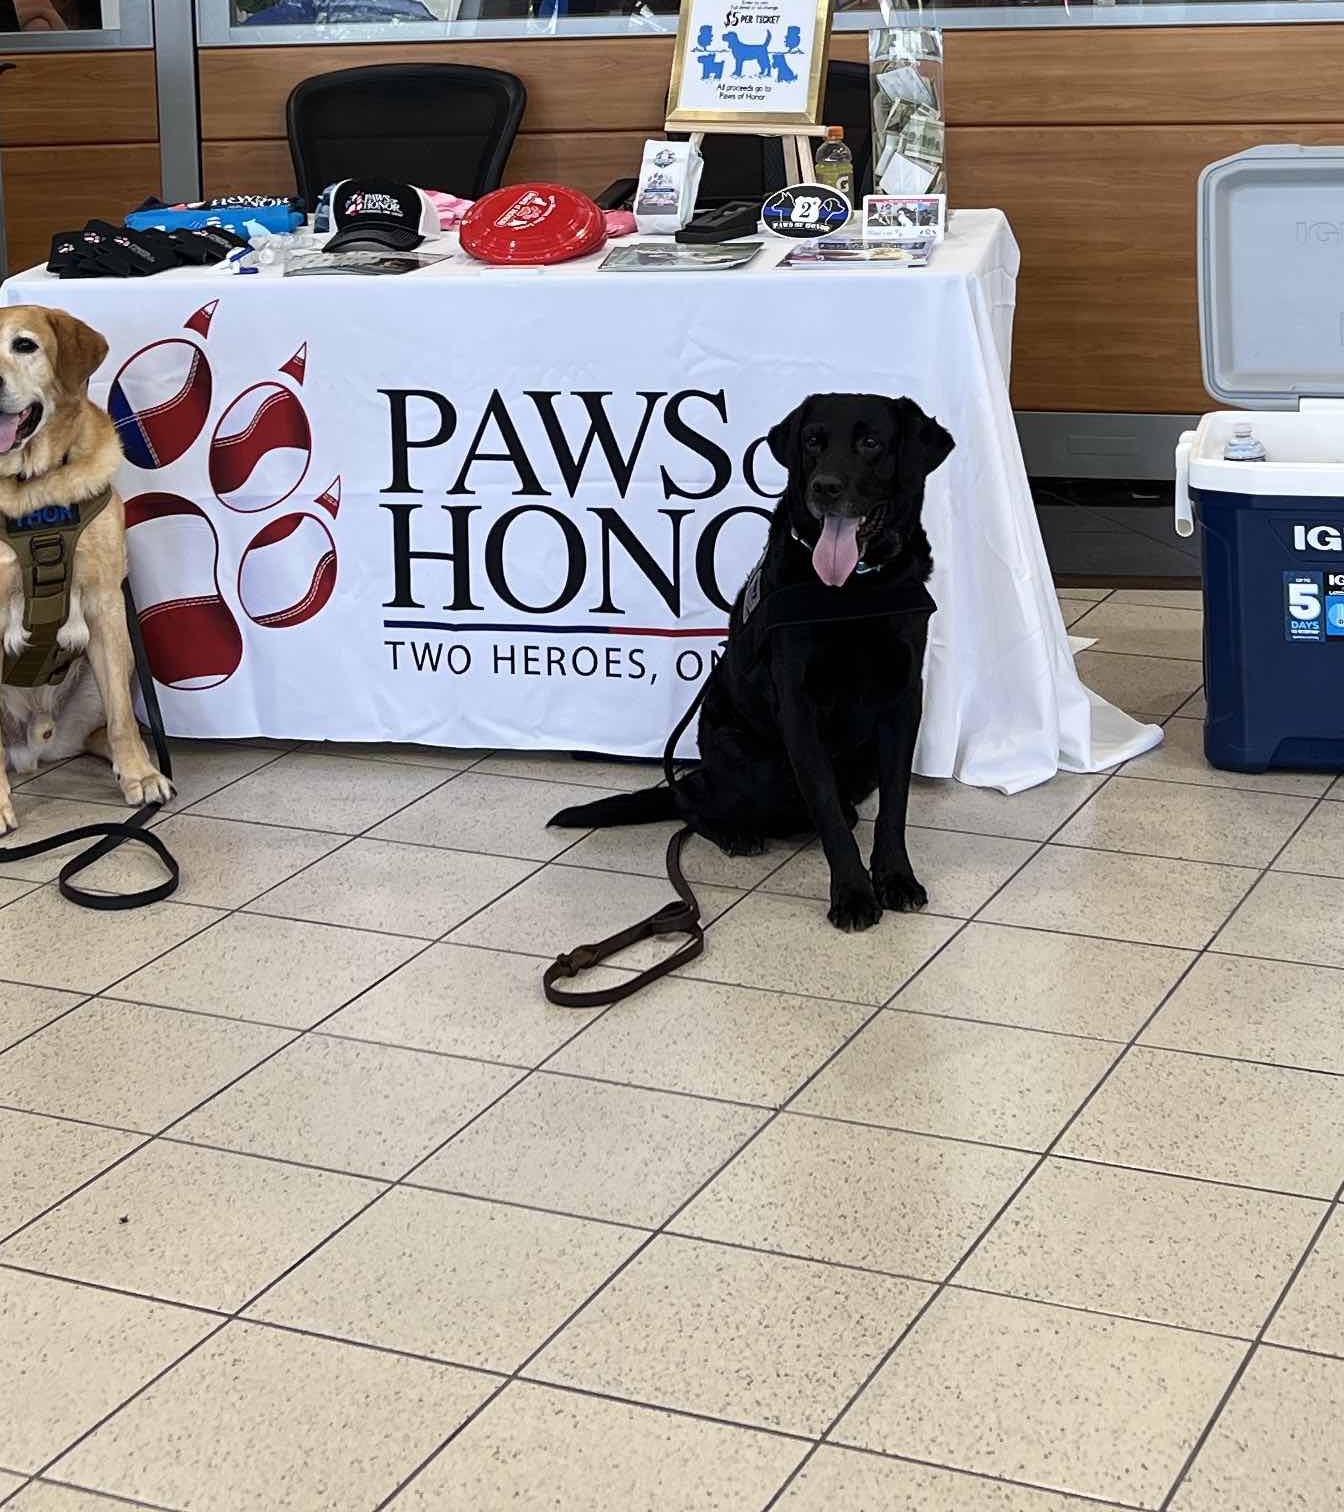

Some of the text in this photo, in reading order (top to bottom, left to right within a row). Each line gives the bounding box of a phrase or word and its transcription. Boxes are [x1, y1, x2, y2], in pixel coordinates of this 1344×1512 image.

[724, 10, 781, 27] $5 PER TICKET
[378, 386, 734, 500] PAWS
[380, 503, 774, 620] HONO
[1288, 583, 1321, 621] 5
[1291, 621, 1320, 630] DAYS
[384, 640, 658, 685] TWO HEROES,
